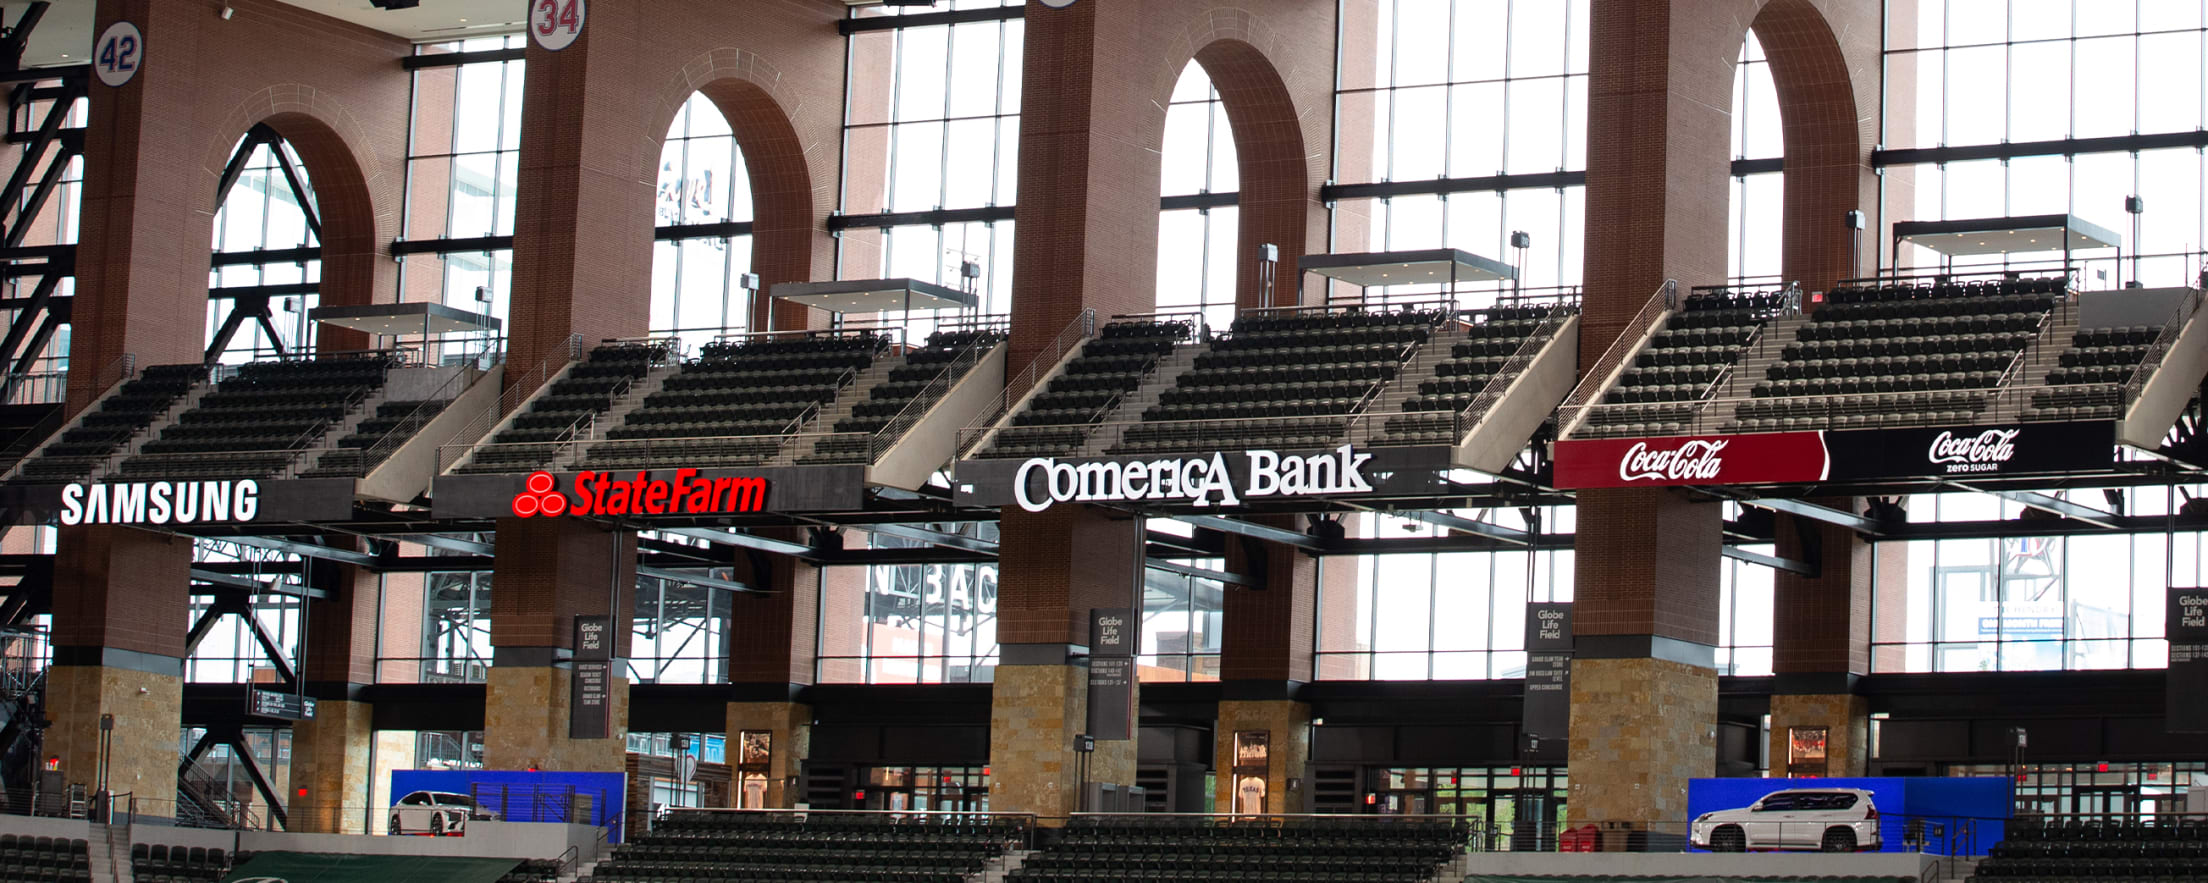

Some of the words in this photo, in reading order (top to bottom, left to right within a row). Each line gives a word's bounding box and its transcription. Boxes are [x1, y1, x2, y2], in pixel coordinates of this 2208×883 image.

[537, 0, 579, 36] 34
[99, 35, 137, 73] 42
[1928, 428, 2020, 464] Coca-Cola
[1619, 439, 1729, 481] Coca-Cola
[1245, 444, 1373, 496] Bank
[1946, 464, 1970, 473] zero
[1970, 463, 1998, 472] SUGAR
[60, 480, 258, 526] SAMSUNG
[2179, 596, 2208, 606] Globe
[1537, 610, 1564, 619] Globe
[2184, 606, 2203, 616] Life
[1098, 616, 1122, 626] Globe
[1542, 620, 1559, 629] Life
[2182, 617, 2205, 627] Field
[581, 623, 603, 632] Globe
[1102, 626, 1118, 635] Life
[584, 632, 598, 640] Life
[1539, 630, 1560, 639] Field
[582, 640, 600, 649] Field
[1100, 635, 1120, 645] Field
